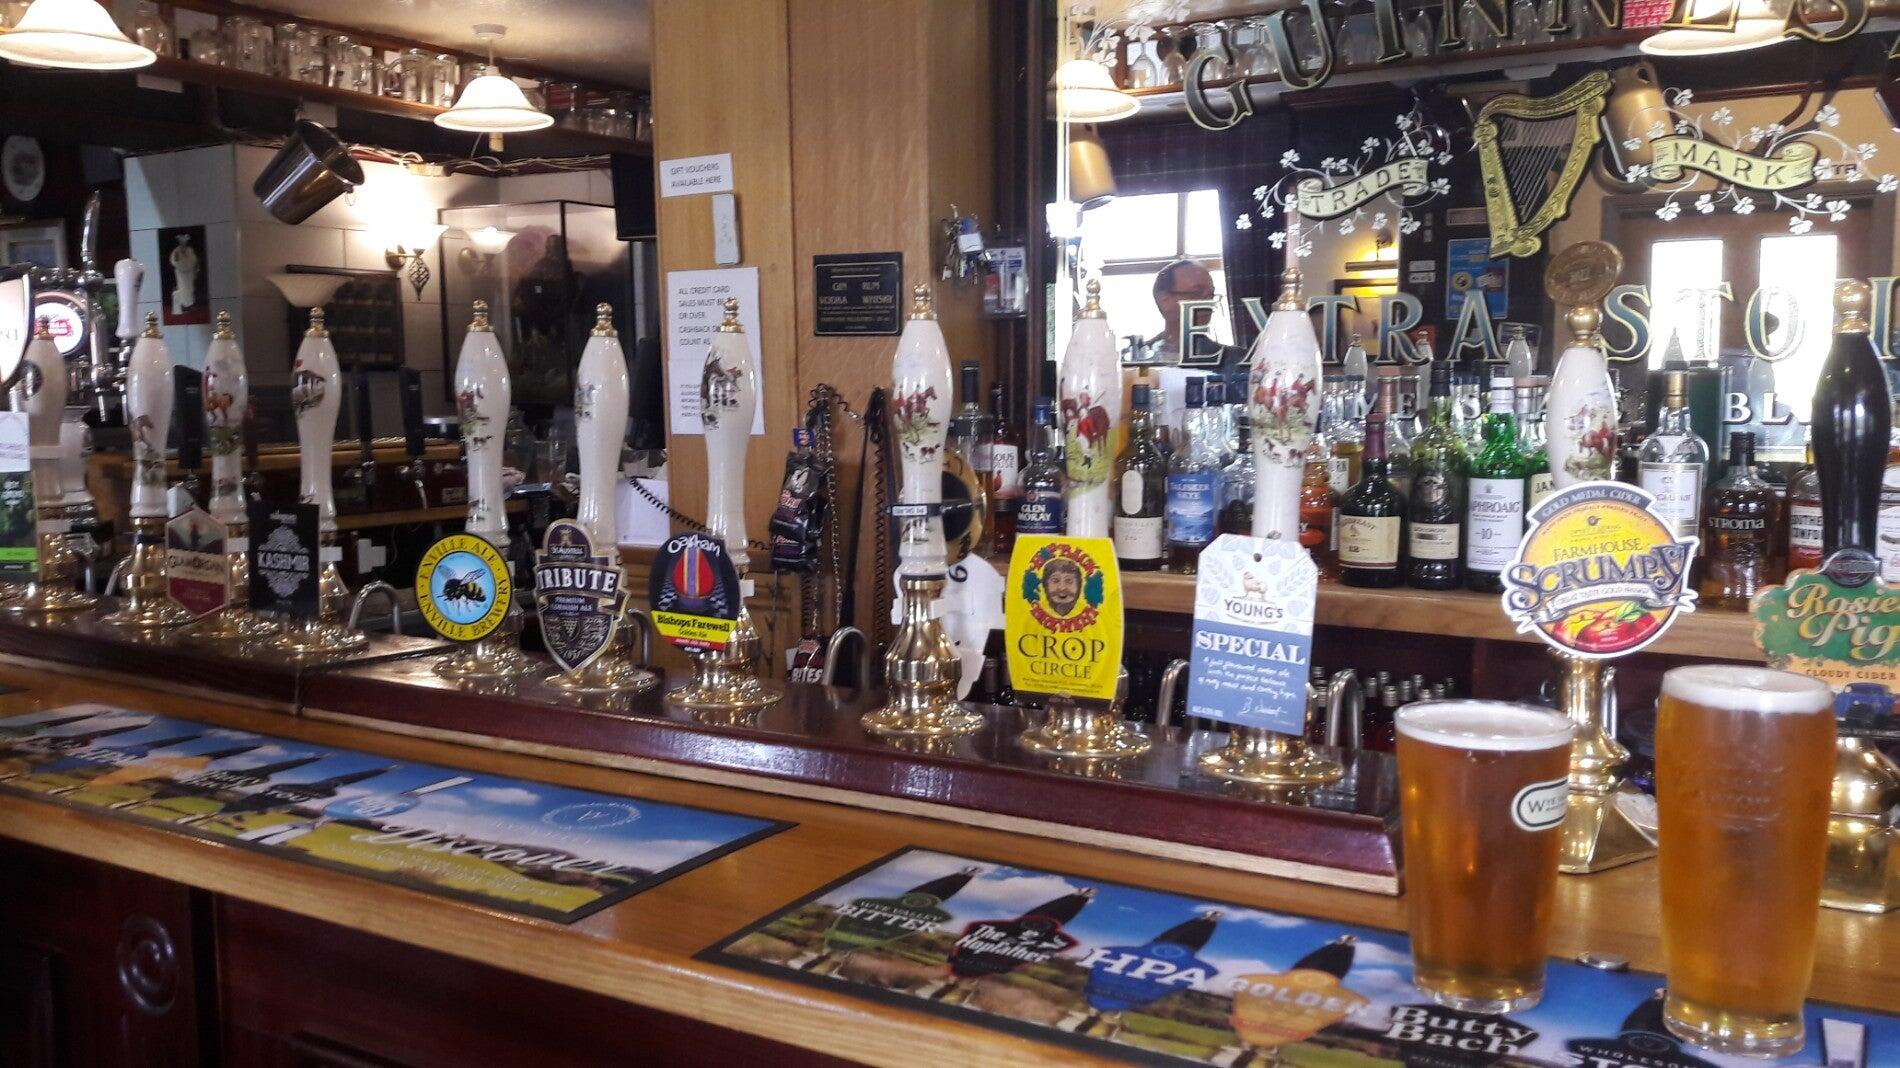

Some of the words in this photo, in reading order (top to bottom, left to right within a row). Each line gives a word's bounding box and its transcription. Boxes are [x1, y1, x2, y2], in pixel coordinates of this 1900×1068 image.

[686, 162, 720, 174] VOUCHERS
[1672, 142, 1787, 185] MARK
[671, 176, 704, 188] AVAILABLE
[705, 175, 722, 184] HERE
[1310, 161, 1411, 213] TRADE
[679, 287, 689, 295] ALL
[690, 286, 712, 295] CREDIT
[712, 285, 731, 293] CARD
[697, 298, 716, 306] MUST
[689, 311, 706, 319] OVER
[679, 338, 702, 346] COUNT
[1021, 504, 1047, 513] GLEN
[1542, 497, 1570, 518] GOLD
[1608, 488, 1642, 505] CIDER
[1018, 512, 1052, 522] MORAY
[667, 534, 721, 558] Oakham
[1481, 528, 1493, 540] 10
[1553, 537, 1643, 561] FARMHOUSE
[257, 551, 310, 572] KASHMIR
[537, 567, 618, 593] TRIBUTE
[1508, 541, 1694, 610] SCRUMPY
[1224, 598, 1284, 619] YOUNG'S
[657, 614, 691, 628] Bishops
[692, 619, 731, 632] Farewell
[1018, 633, 1105, 663] CROP
[1196, 630, 1307, 665] SPECIAL
[1799, 612, 1900, 660] Pig
[792, 666, 824, 683] BITES
[1030, 660, 1092, 680] CIRCLE
[1805, 668, 1851, 679] CLOUDY
[1856, 671, 1897, 681] CIDER
[351, 823, 630, 875] Discover
[834, 903, 943, 934] BITTER
[975, 924, 1007, 941] The
[955, 934, 1051, 963] Hopfather
[1076, 948, 1208, 991] HPA
[1224, 977, 1373, 1018] GOLDEN
[1390, 1006, 1536, 1042] Butty
[1383, 1022, 1519, 1056] Bach
